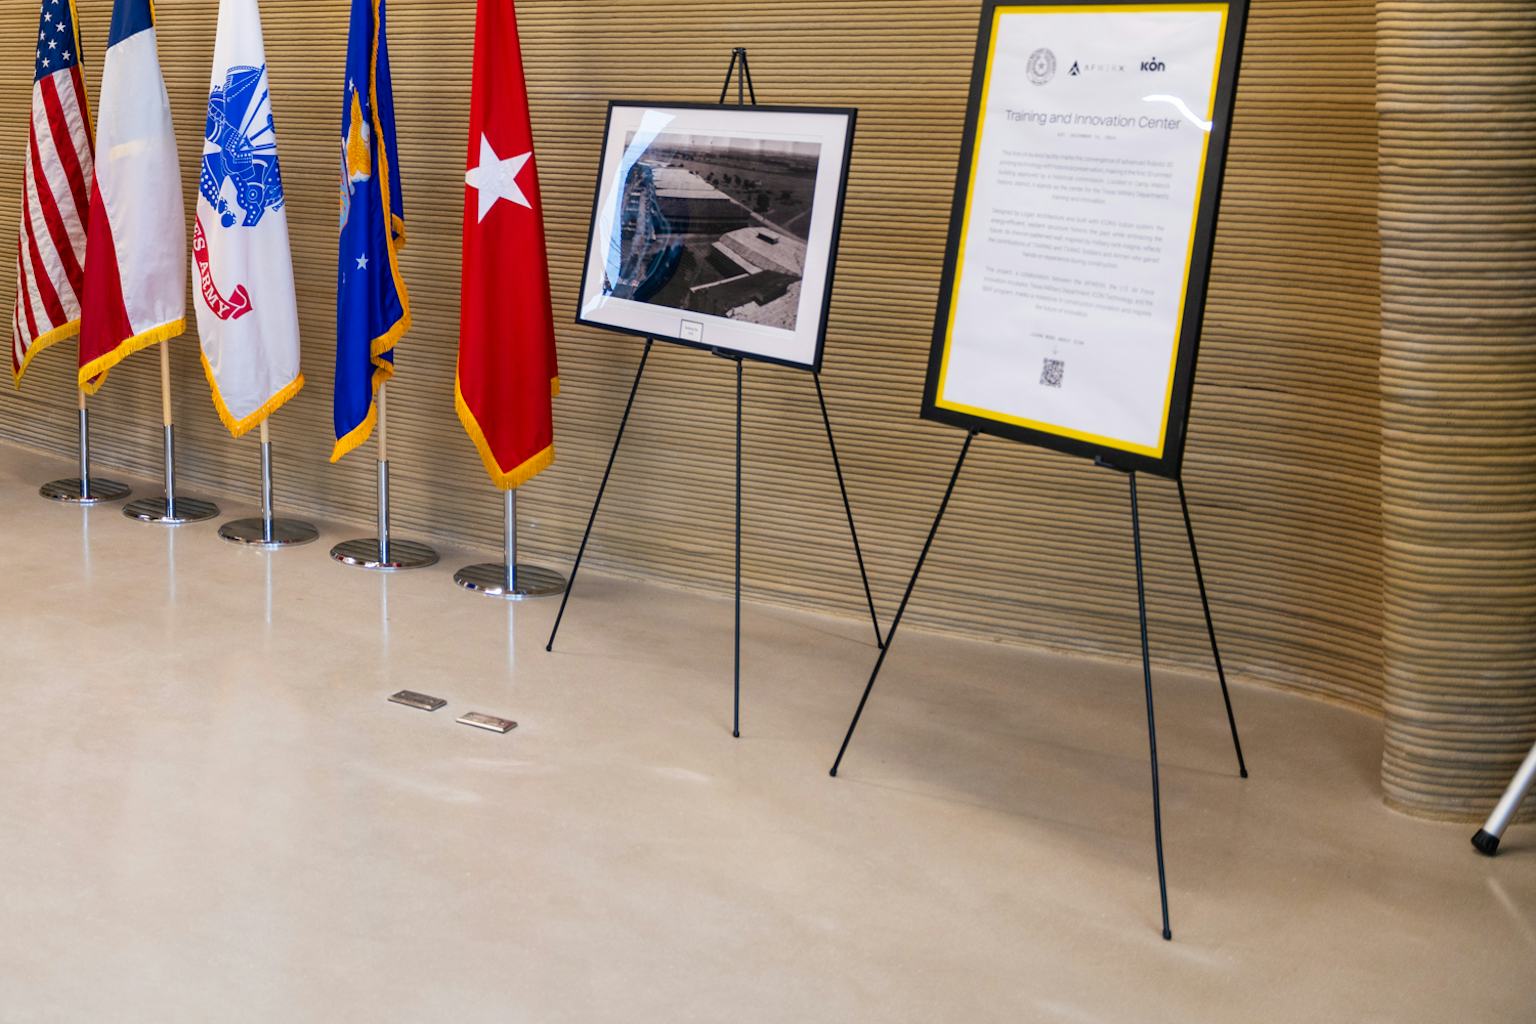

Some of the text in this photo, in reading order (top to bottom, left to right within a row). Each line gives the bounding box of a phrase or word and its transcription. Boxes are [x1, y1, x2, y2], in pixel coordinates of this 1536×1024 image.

[1005, 108, 1182, 130] Training and Innovation Center
[198, 260, 231, 318] ARMY
